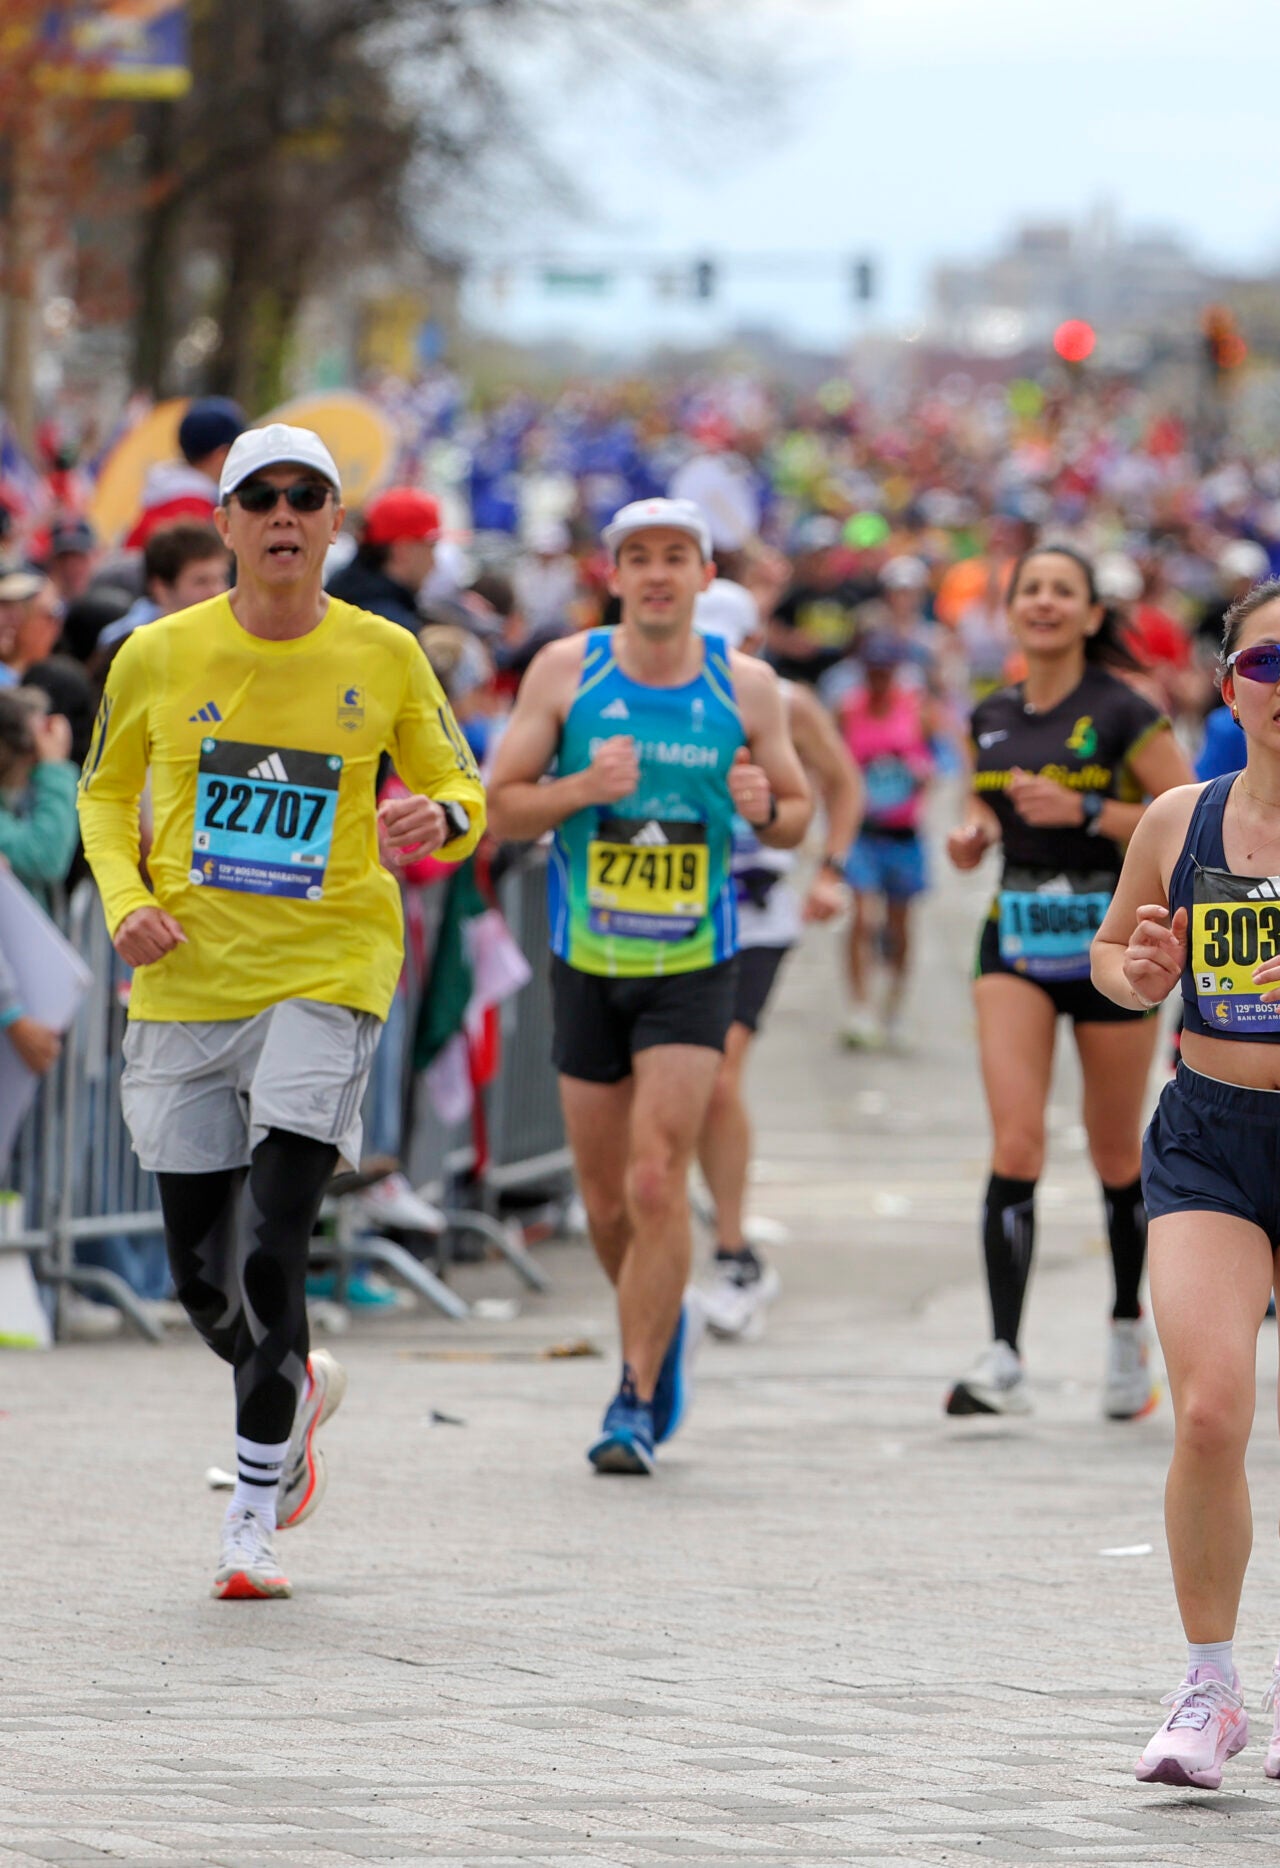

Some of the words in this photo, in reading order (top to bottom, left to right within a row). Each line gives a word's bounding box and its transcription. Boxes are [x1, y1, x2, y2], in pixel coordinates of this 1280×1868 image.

[204, 780, 328, 842] 22707
[599, 850, 697, 892] 27419
[1201, 976, 1212, 989] 5
